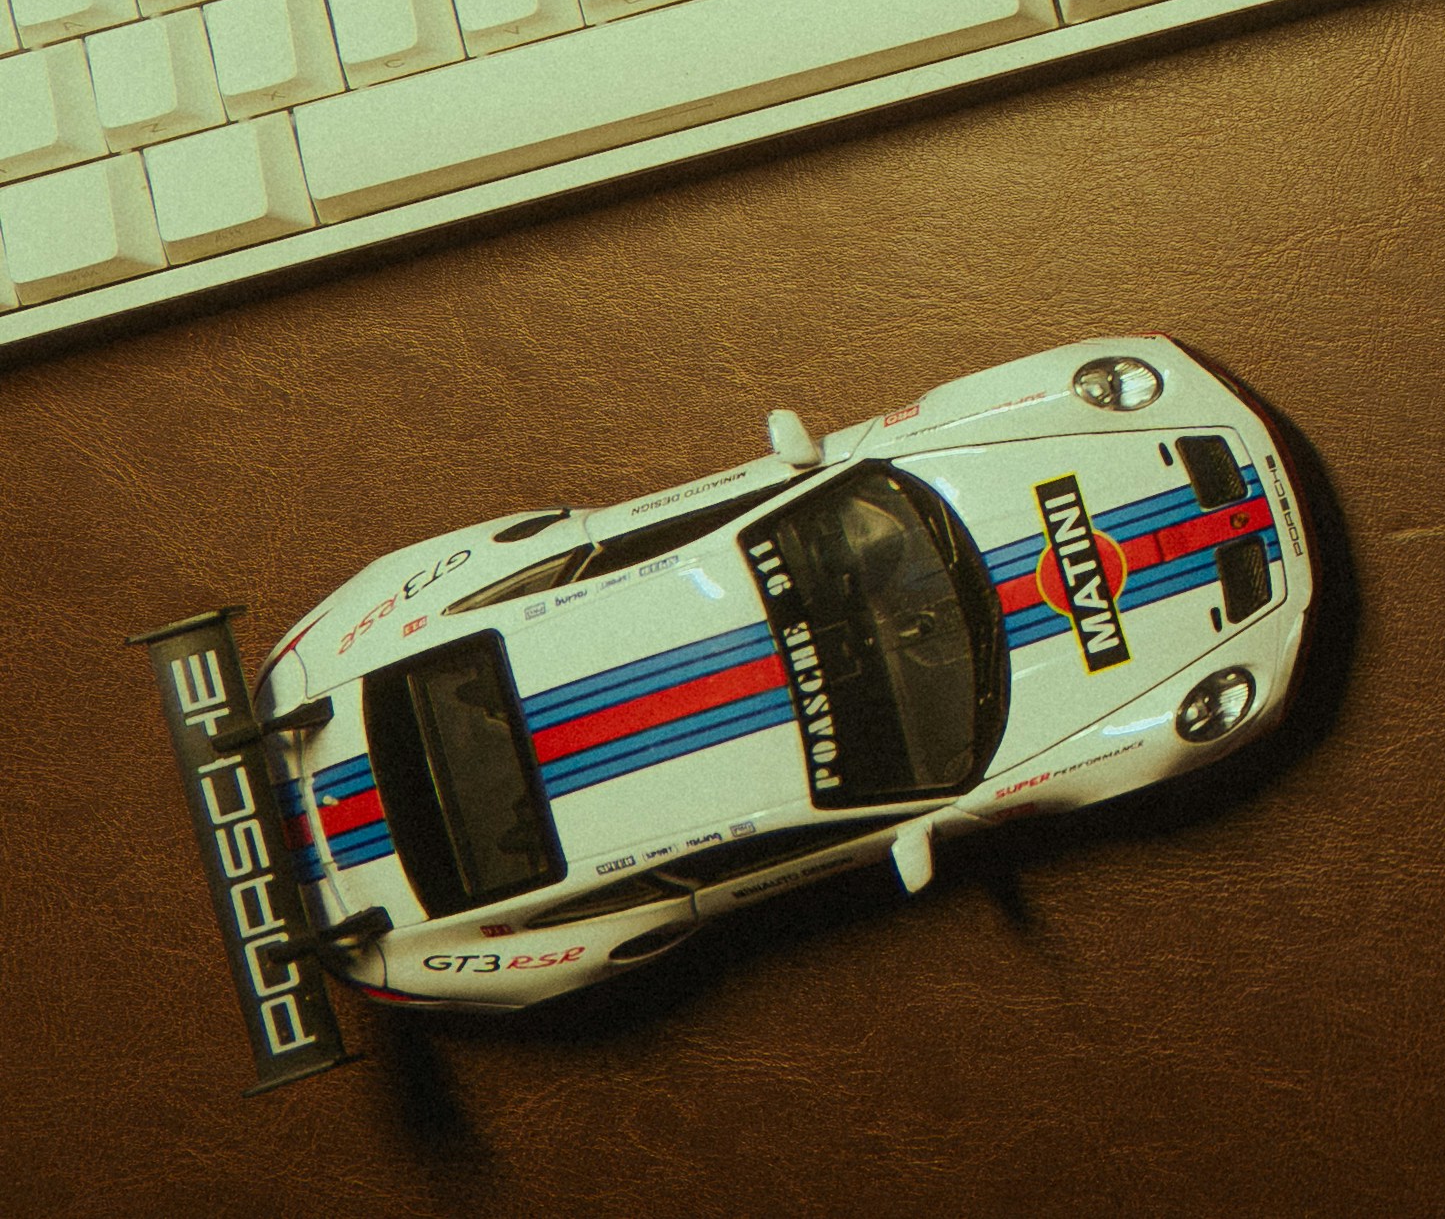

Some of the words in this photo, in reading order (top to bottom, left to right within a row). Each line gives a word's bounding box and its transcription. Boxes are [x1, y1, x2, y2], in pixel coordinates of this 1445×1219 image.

[63, 19, 84, 32] A
[502, 25, 521, 36] V
[383, 58, 405, 69] C
[267, 89, 288, 101] X
[143, 122, 168, 134] Z
[684, 470, 748, 499] MINIAUTO
[631, 493, 682, 516] DESIGN
[403, 549, 472, 600] GT3
[749, 539, 794, 597] 911
[1044, 491, 1120, 654] MATINI
[337, 592, 400, 656] RSR
[995, 772, 1051, 799] SUPER
[1052, 739, 1145, 778] PERFORMANCE
[422, 953, 501, 974] GT3
[506, 945, 586, 970] RSR
